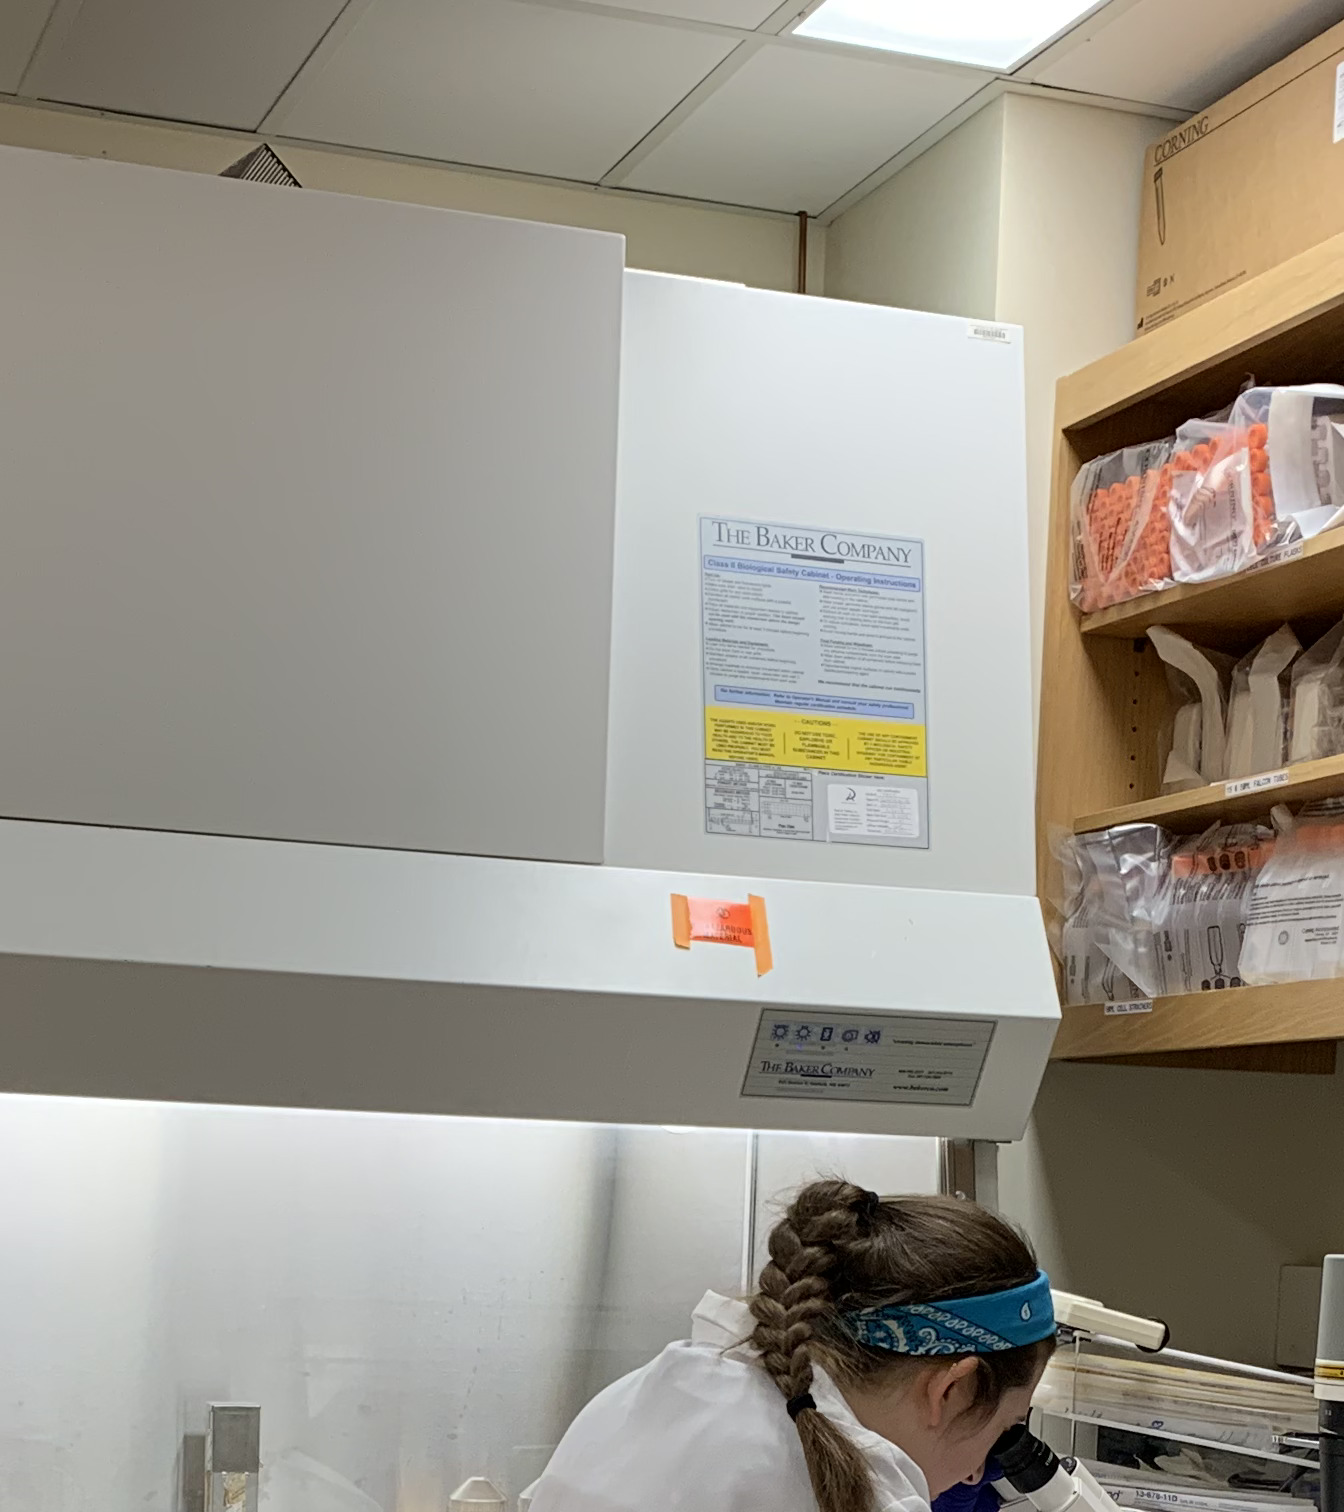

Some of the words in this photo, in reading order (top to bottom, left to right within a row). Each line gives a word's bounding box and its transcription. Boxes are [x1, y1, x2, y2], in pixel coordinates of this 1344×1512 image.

[1154, 115, 1210, 164] CORNING
[707, 558, 728, 568] Class
[737, 562, 774, 573] Biological
[776, 566, 799, 576] Safety
[801, 568, 829, 579] Cabinet
[835, 572, 871, 583] Operating
[873, 576, 916, 588] Instructions
